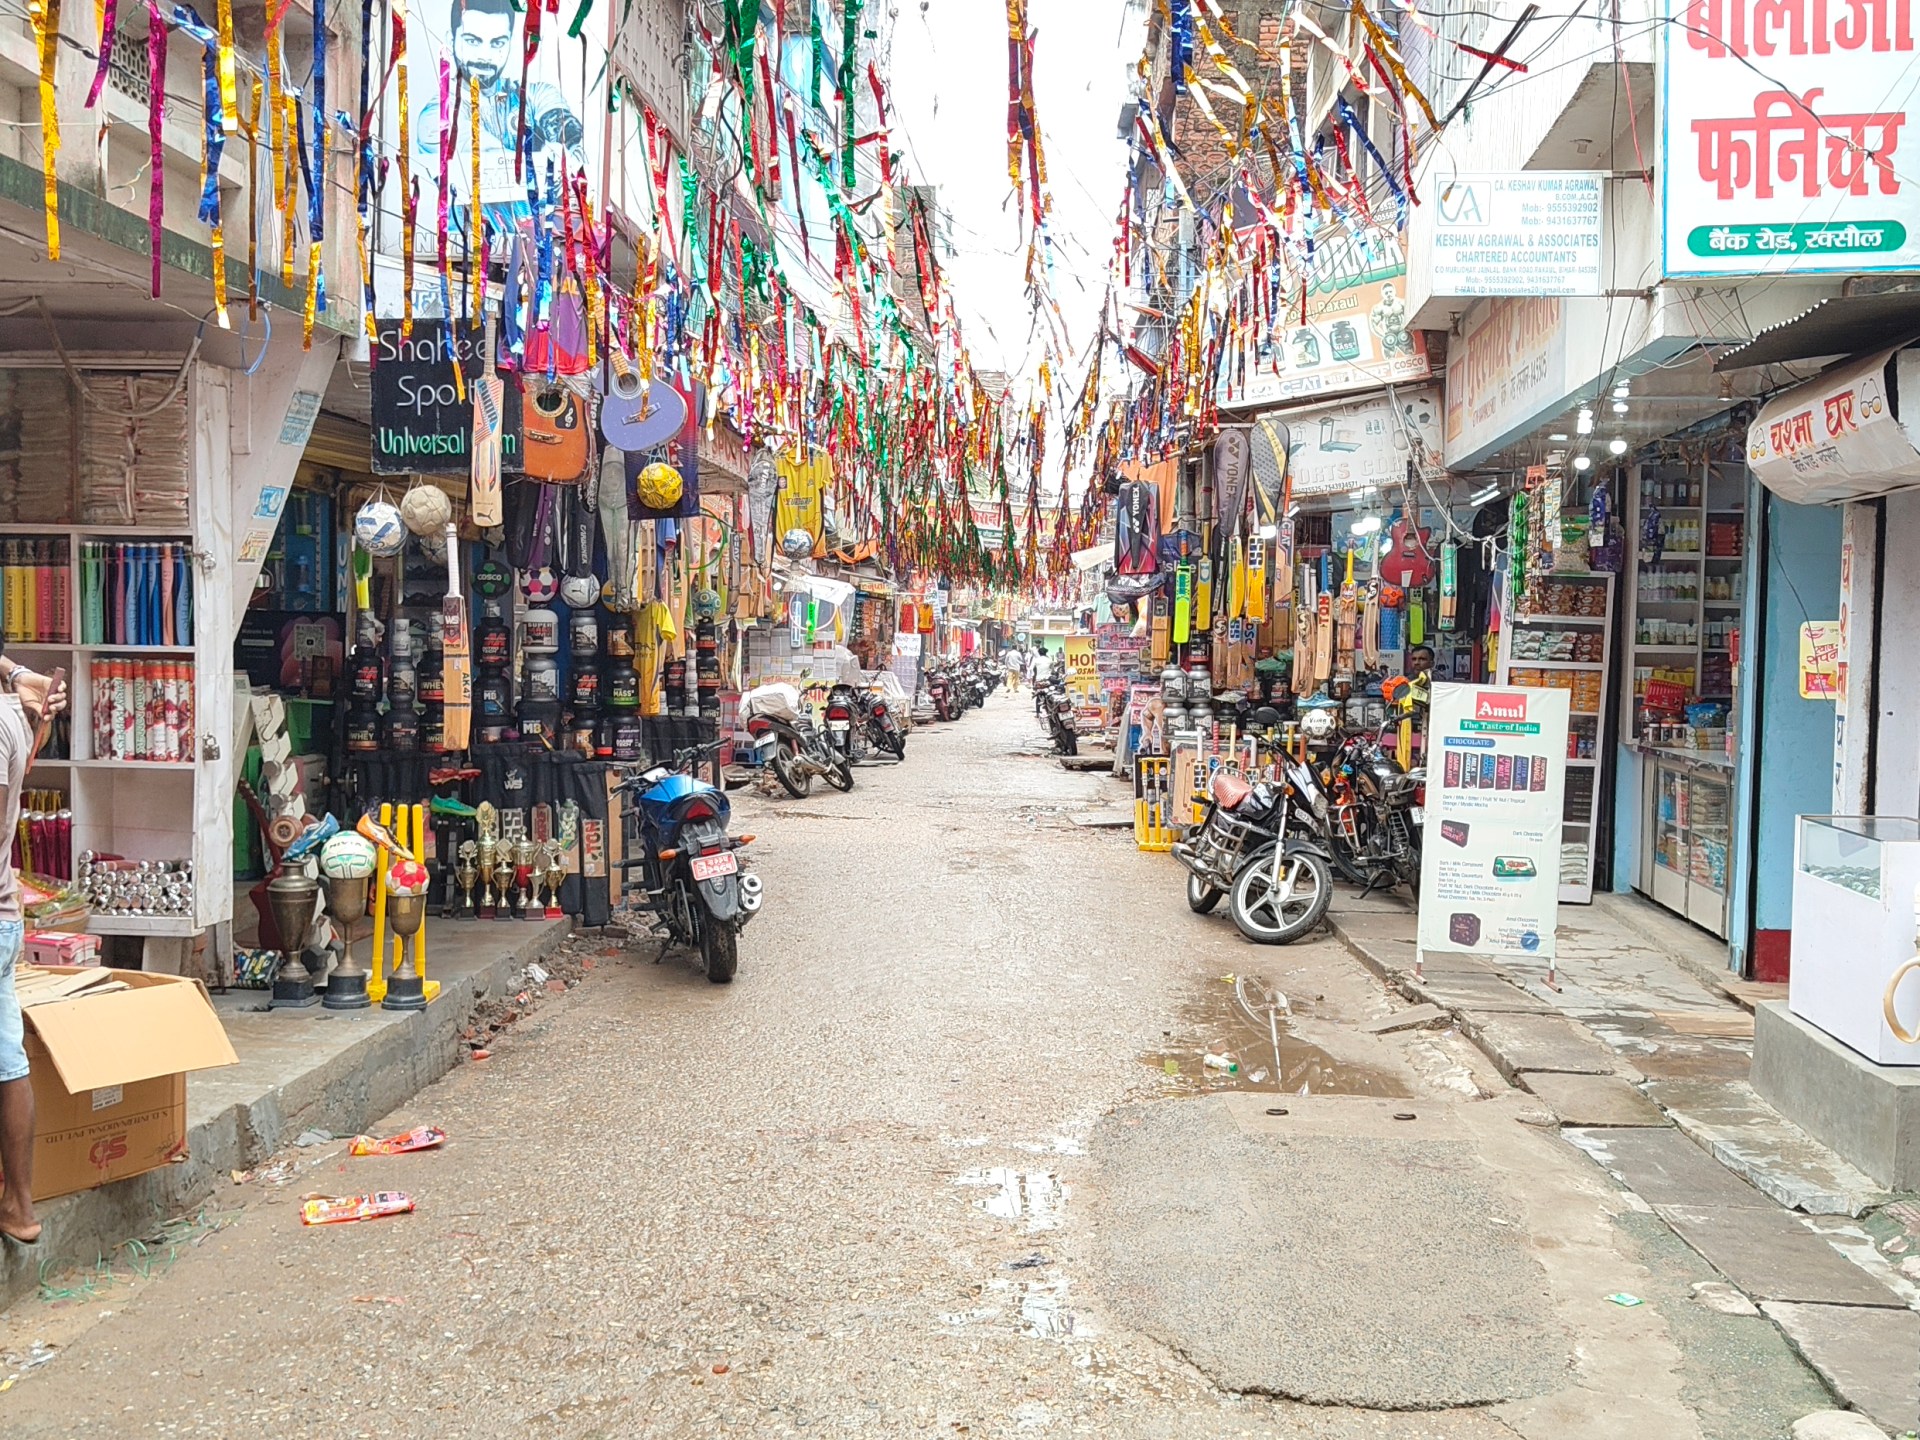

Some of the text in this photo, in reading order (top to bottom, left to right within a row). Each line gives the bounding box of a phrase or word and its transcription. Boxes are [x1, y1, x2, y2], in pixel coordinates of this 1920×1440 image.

[1690, 87, 1906, 200] फर्निचर
[1507, 180, 1537, 191] KESHAV
[1538, 180, 1563, 191] KUMAR
[1564, 179, 1599, 191] AGRAWAL
[1521, 202, 1598, 213] Mob:- 9555392902
[1546, 216, 1598, 226] 9431637767
[1435, 233, 1599, 247] KESHAV AGRAWAL & ASSOCIATES
[1708, 226, 1752, 252] बैंक
[1804, 224, 1885, 249] रक्सौल
[1455, 251, 1577, 263] CHARTERED ACCOUNTANTS
[1316, 294, 1359, 316] Raxaul
[1394, 357, 1424, 370] COSCO
[1770, 389, 1858, 455] चश्मा घर
[1132, 486, 1140, 516] YONEX
[477, 573, 502, 581] COSCO
[1319, 596, 1330, 624] TON
[444, 615, 460, 625] WS
[462, 672, 471, 699] AK 47
[613, 690, 633, 698] MASS
[1478, 701, 1524, 719] Amul
[522, 722, 542, 735] MB
[1463, 721, 1538, 732] The Taste of India
[350, 732, 375, 740] WHEY
[1448, 738, 1490, 746] CHOCOLATE
[504, 780, 523, 790] WS
[88, 1114, 150, 1136] INTERNATIONAL
